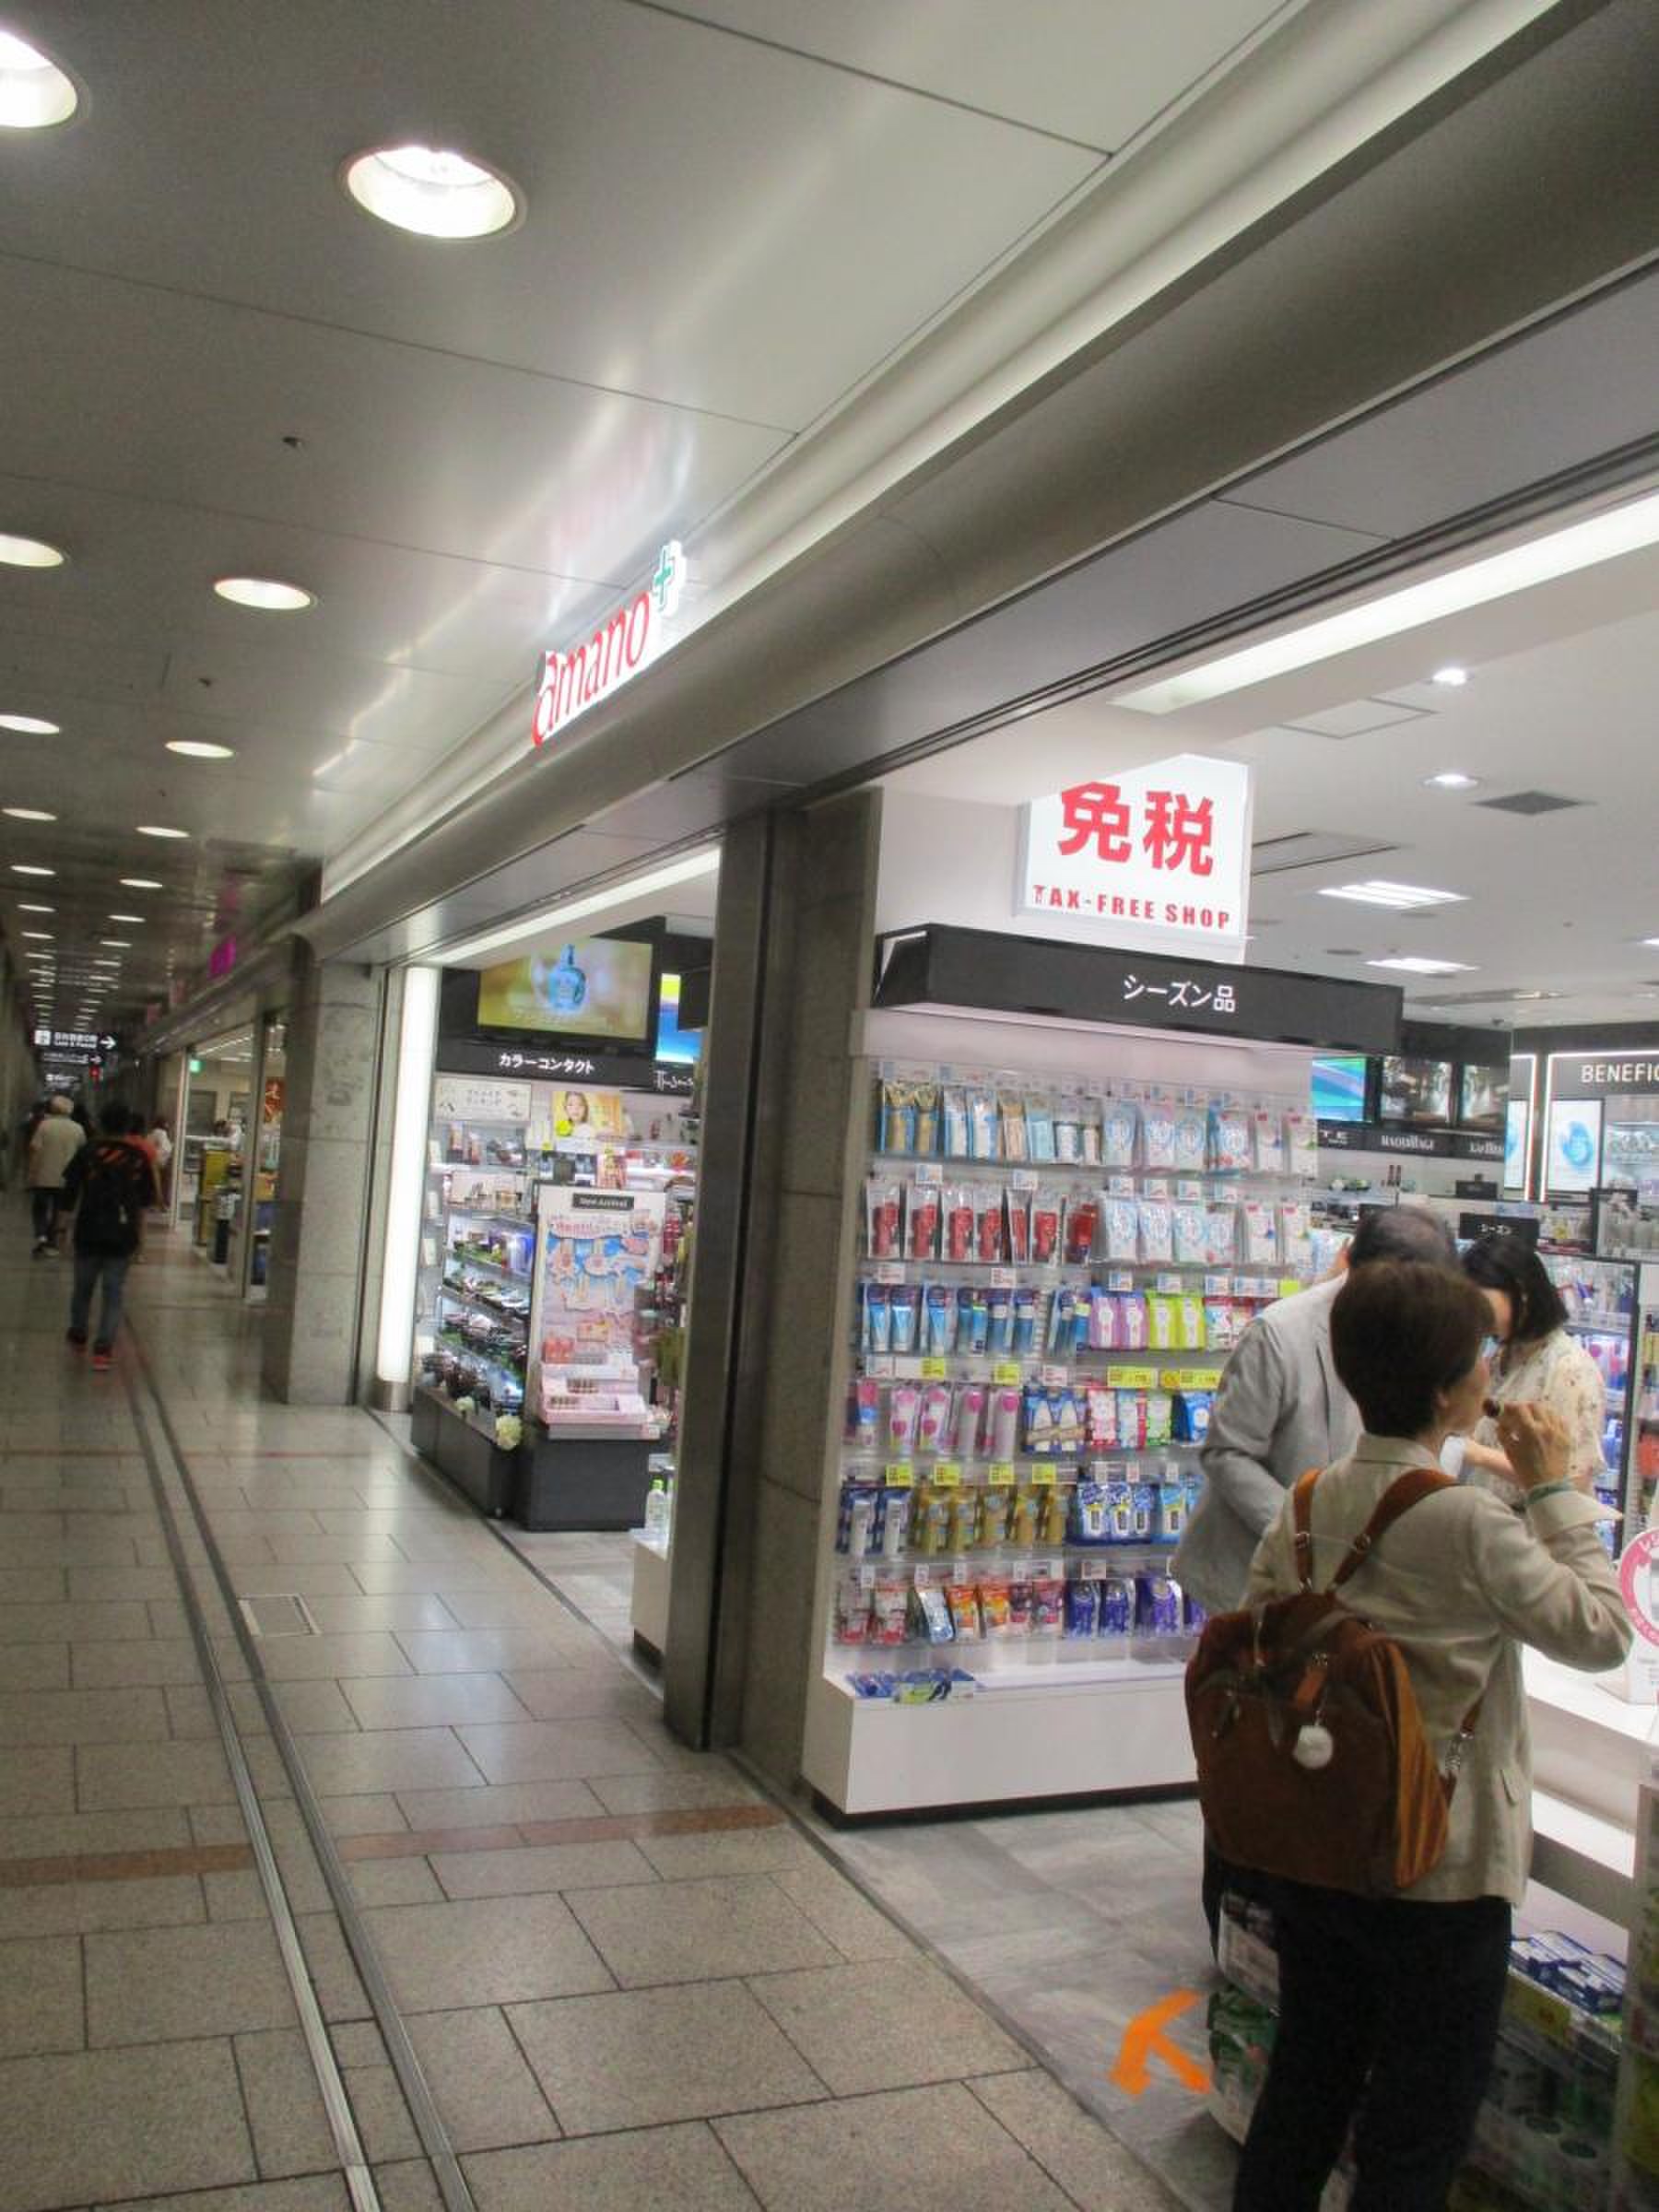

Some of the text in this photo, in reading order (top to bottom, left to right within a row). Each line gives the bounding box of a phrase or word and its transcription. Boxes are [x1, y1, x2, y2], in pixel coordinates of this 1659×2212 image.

[1058, 781, 1214, 877] 免税
[1033, 884, 1230, 929] TAX-FREE SHOP
[1123, 973, 1236, 1013] シーズン品
[499, 1053, 595, 1075] カラーコンタクト
